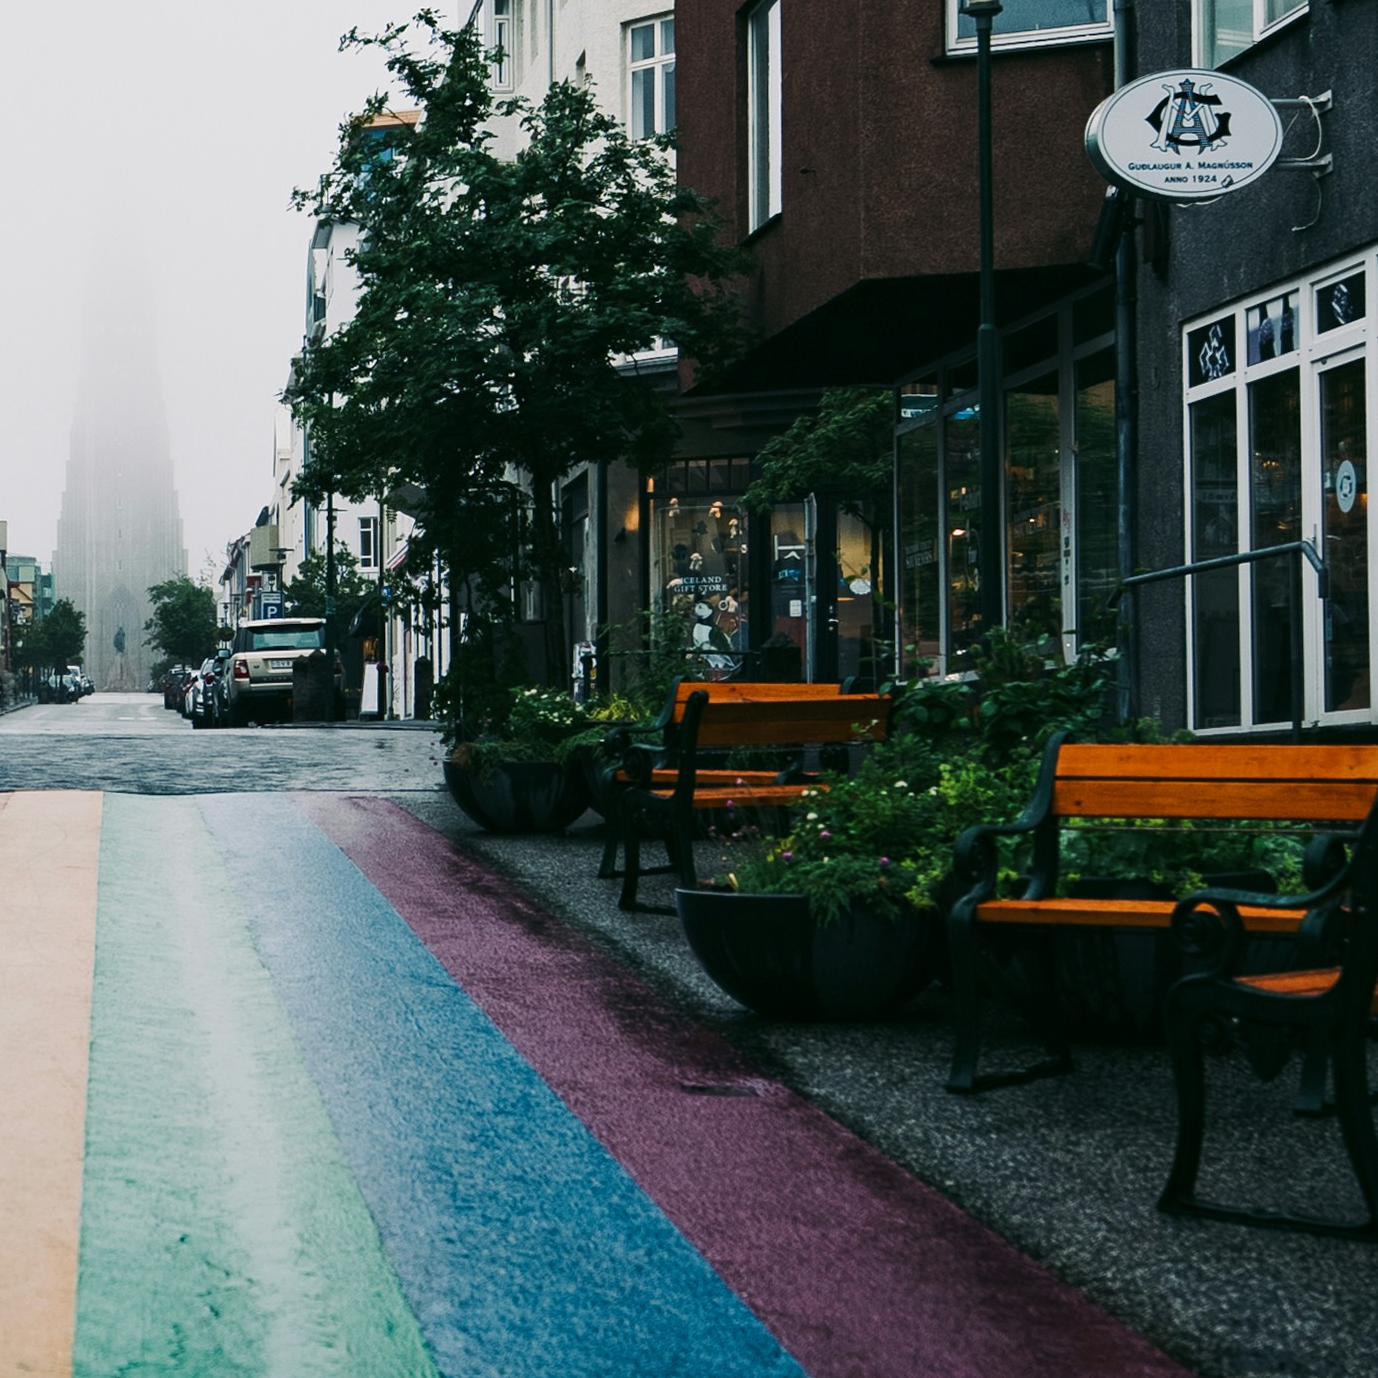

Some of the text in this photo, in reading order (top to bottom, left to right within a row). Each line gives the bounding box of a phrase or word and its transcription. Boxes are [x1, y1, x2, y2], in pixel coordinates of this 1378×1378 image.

[1185, 162, 1194, 170] A.
[1192, 175, 1217, 183] 1924
[680, 576, 721, 584] ICELAND
[699, 584, 728, 592] STORE
[267, 605, 277, 618] P
